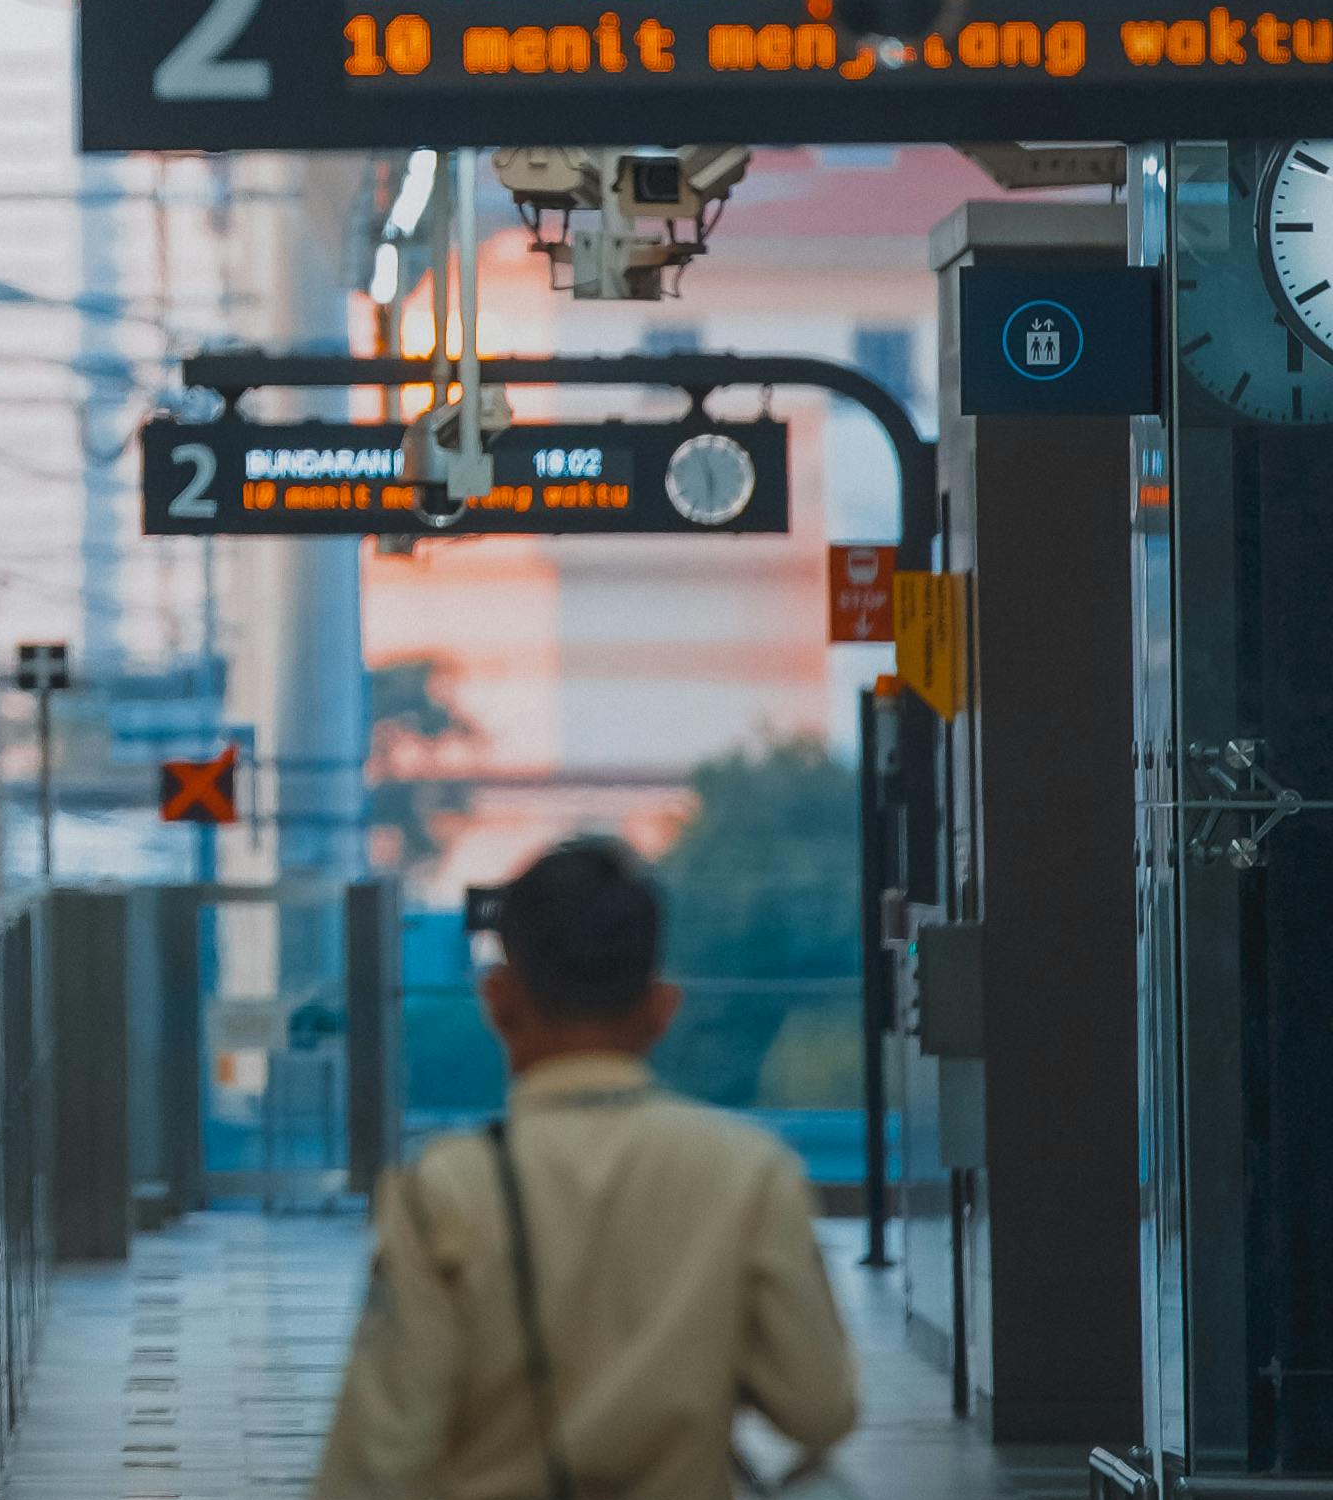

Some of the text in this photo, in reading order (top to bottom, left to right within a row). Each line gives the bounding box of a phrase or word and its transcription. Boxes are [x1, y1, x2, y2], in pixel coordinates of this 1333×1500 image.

[344, 6, 1333, 81] 10 menit menjlang waktu
[168, 443, 218, 518] 2
